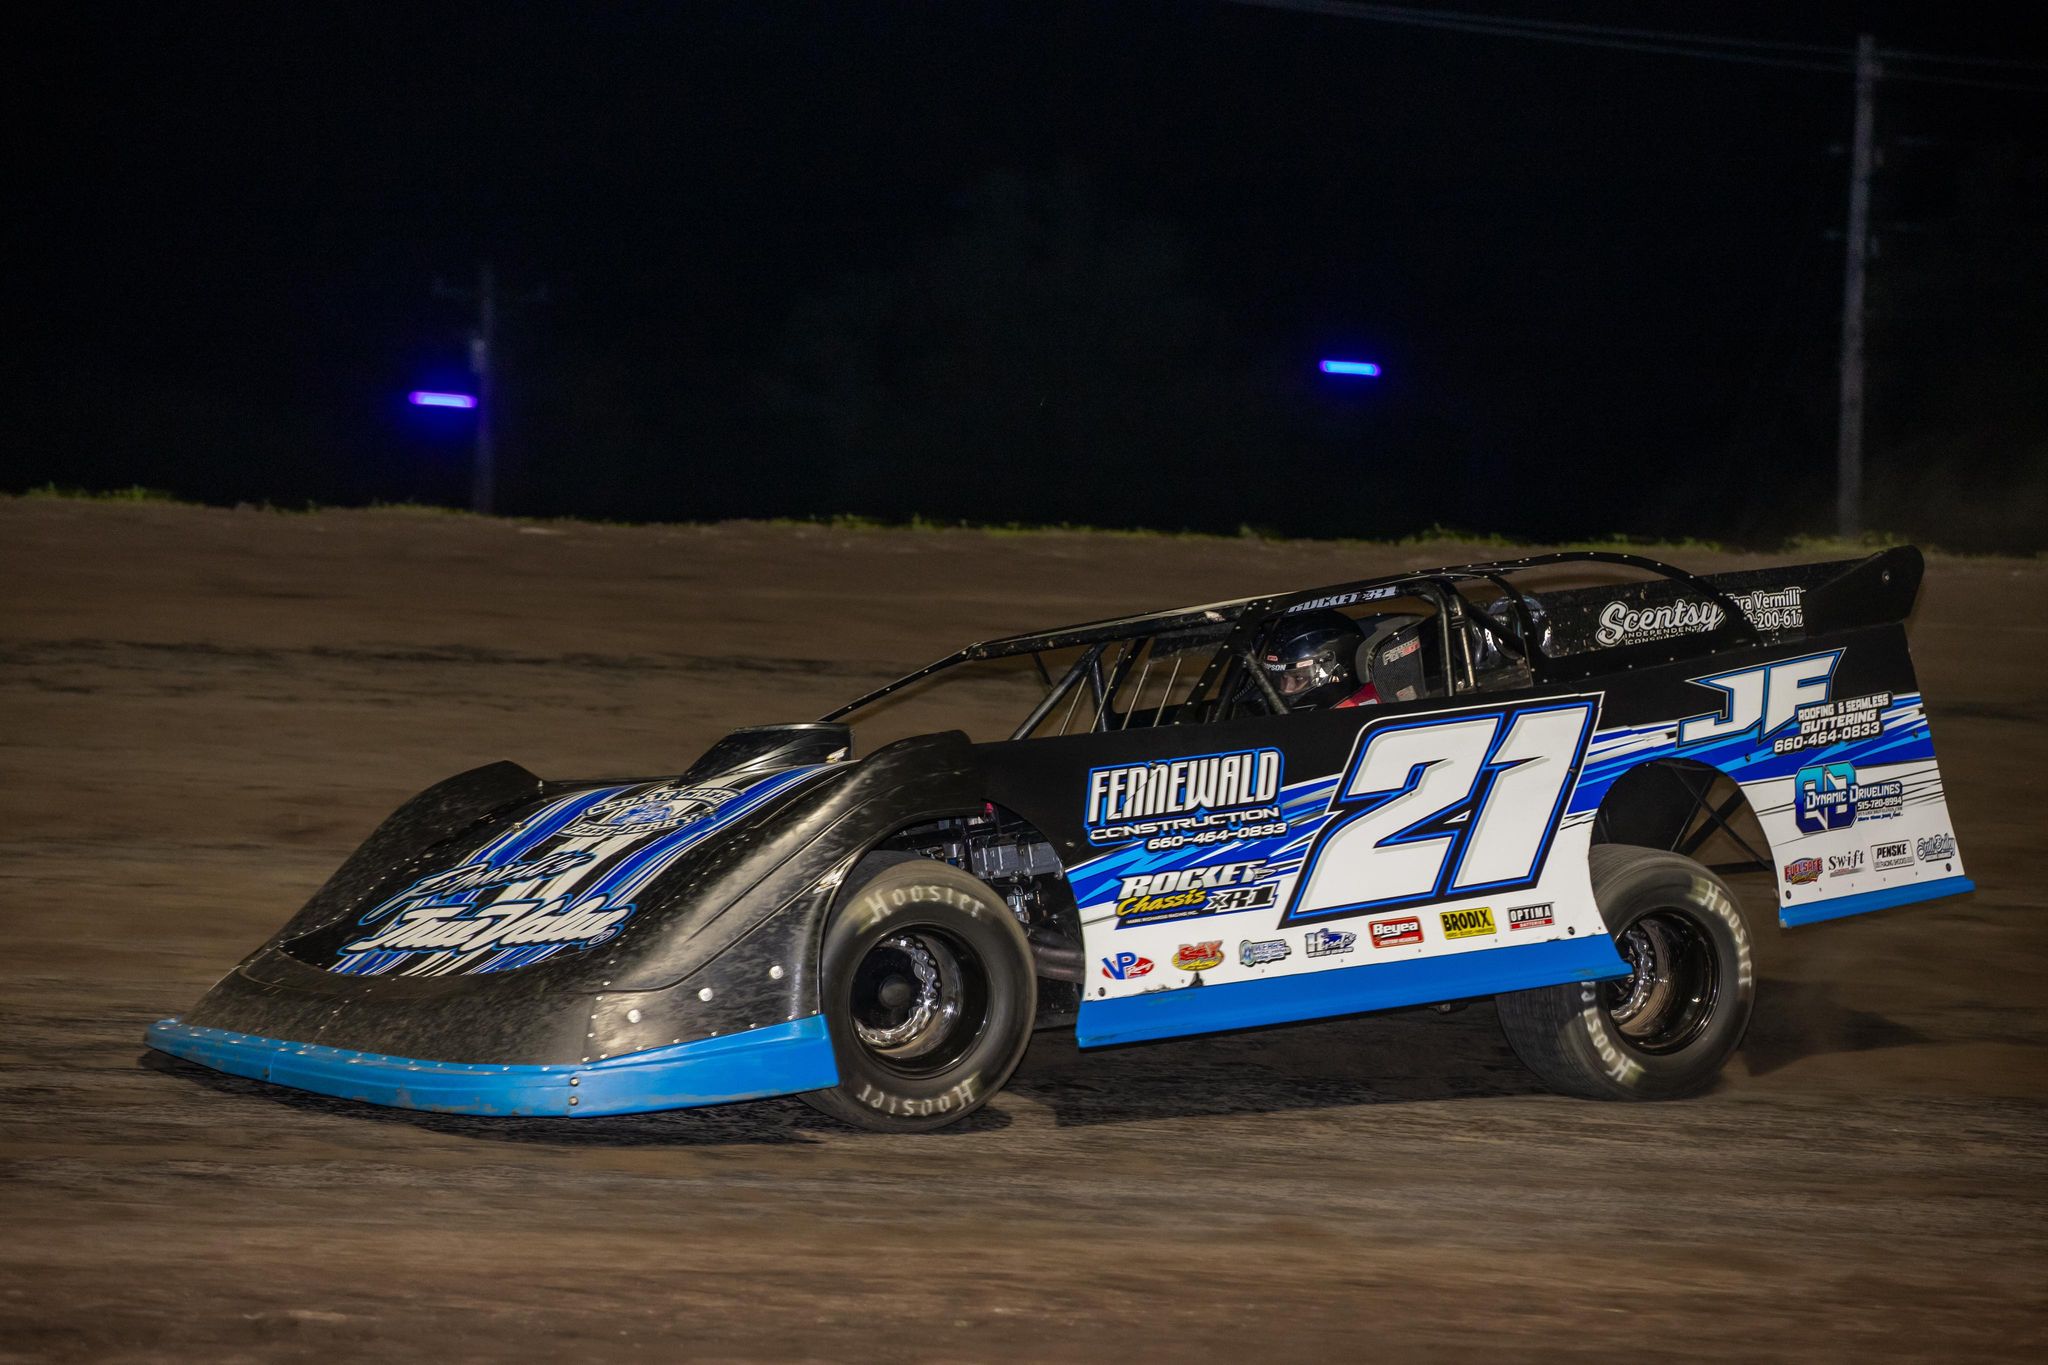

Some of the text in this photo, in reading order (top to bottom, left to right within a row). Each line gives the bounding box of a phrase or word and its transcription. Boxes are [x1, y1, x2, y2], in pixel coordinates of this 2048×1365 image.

[1597, 599, 1725, 646] Scentsy
[1680, 653, 1840, 744] JF
[1798, 702, 1835, 722] ROOFING
[1845, 694, 1889, 712] SEAMLESS
[1801, 709, 1877, 735] GUTTERING
[1774, 722, 1880, 753] 660-464-0833
[1087, 751, 1280, 823] FENNEWALD
[1806, 782, 1901, 810] DYNAMIC DRIVELINES
[1296, 704, 1589, 914] 21
[1089, 806, 1279, 841] CONSTRUCTION
[1147, 822, 1288, 850] 660-464-0833
[1828, 849, 1864, 871] Swift
[1876, 843, 1907, 859] PENSKE
[1118, 859, 1267, 900] ROCKET
[1116, 888, 1207, 916] Chassis
[1510, 905, 1553, 922] OPTIMA
[345, 905, 494, 951] True
[1373, 921, 1419, 938] Beyea
[1441, 909, 1491, 932] BRODIX
[1102, 951, 1136, 980] VP
